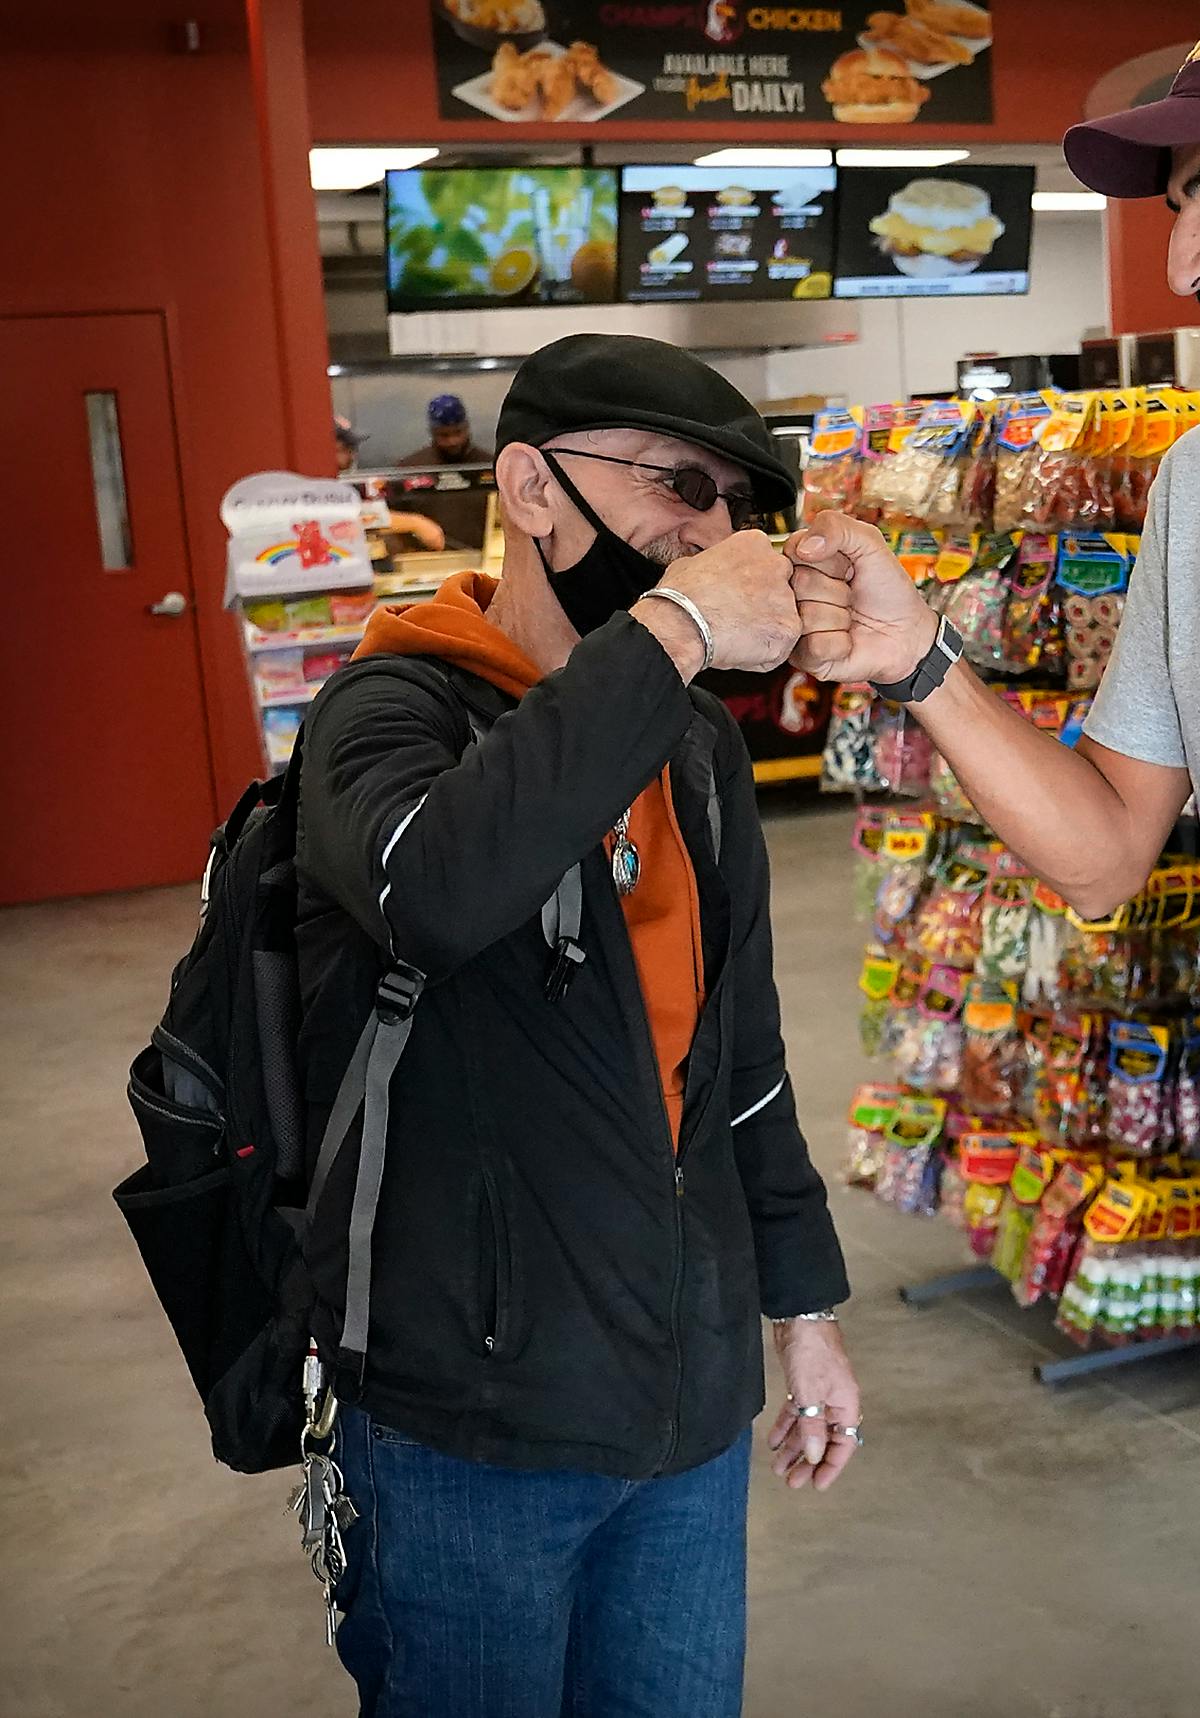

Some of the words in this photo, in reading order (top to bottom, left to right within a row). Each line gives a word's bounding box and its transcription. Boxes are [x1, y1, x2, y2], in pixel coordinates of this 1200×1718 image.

[747, 7, 842, 31] CHICKEN
[663, 54, 746, 76] AVAILABLE
[749, 55, 791, 77] HERE
[731, 82, 805, 112] DAILY!
